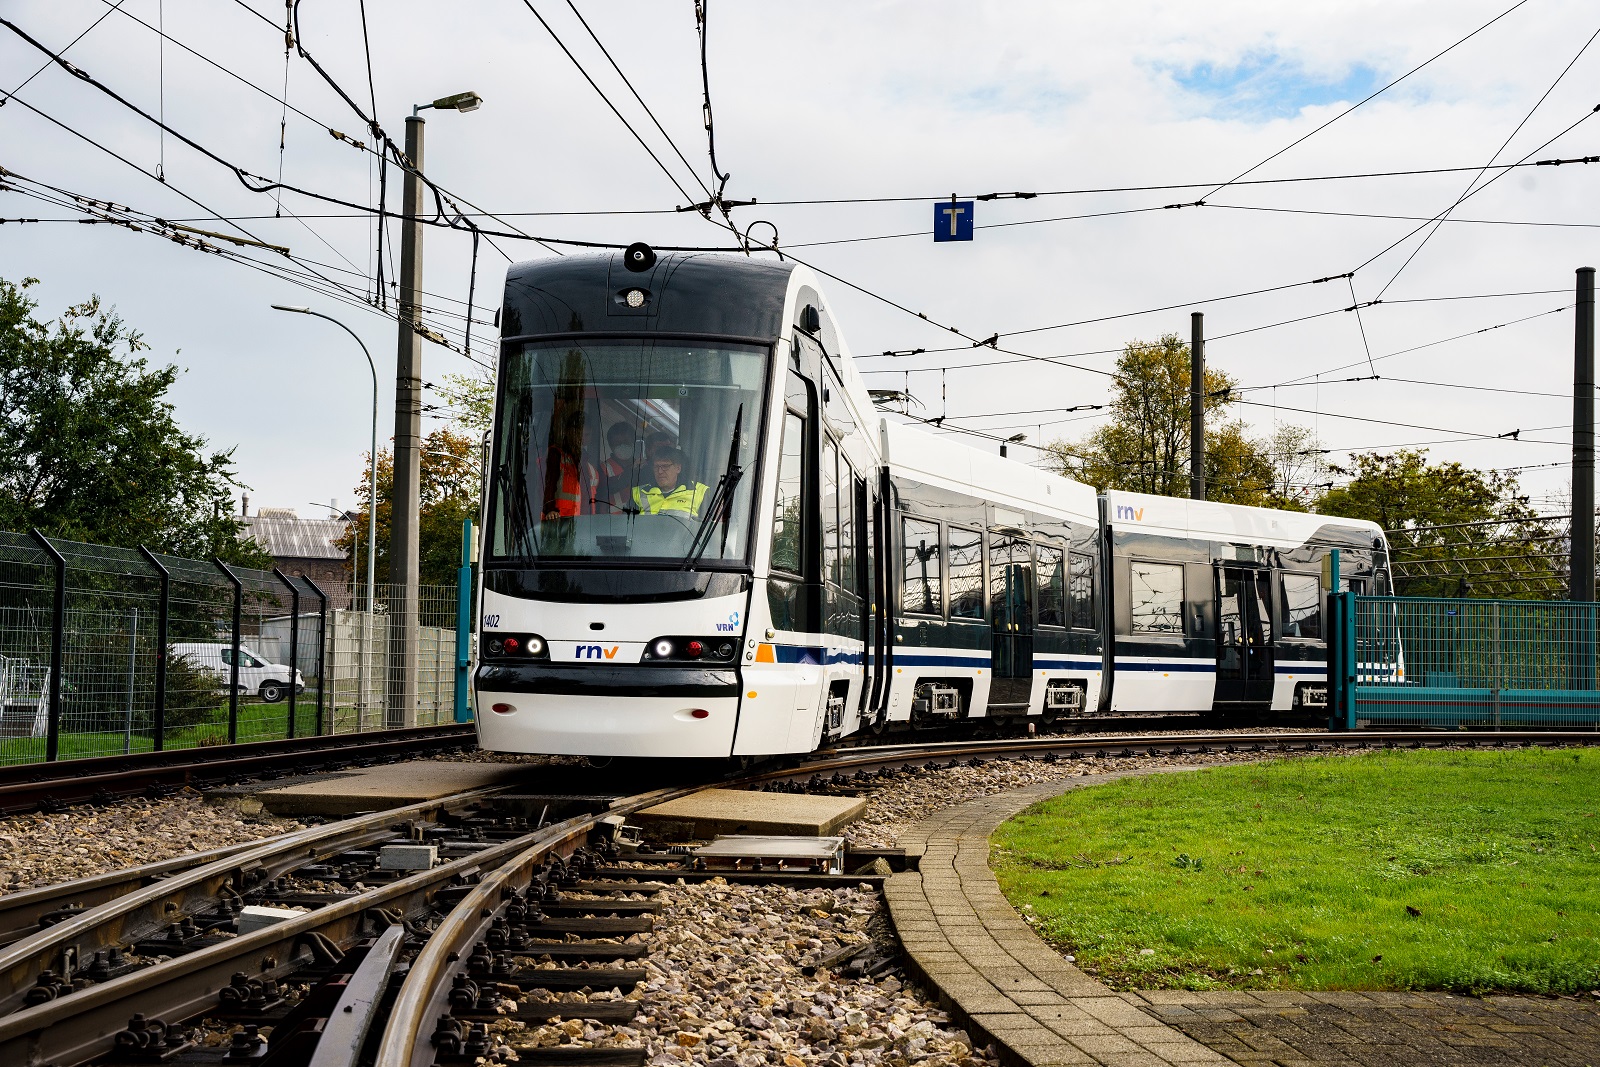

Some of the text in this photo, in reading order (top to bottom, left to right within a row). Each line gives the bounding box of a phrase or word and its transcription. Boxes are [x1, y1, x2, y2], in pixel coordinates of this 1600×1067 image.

[943, 208, 965, 236] T
[1117, 505, 1144, 521] rnv
[483, 614, 500, 628] 1402
[716, 623, 734, 631] VRN
[575, 645, 619, 659] rnv
